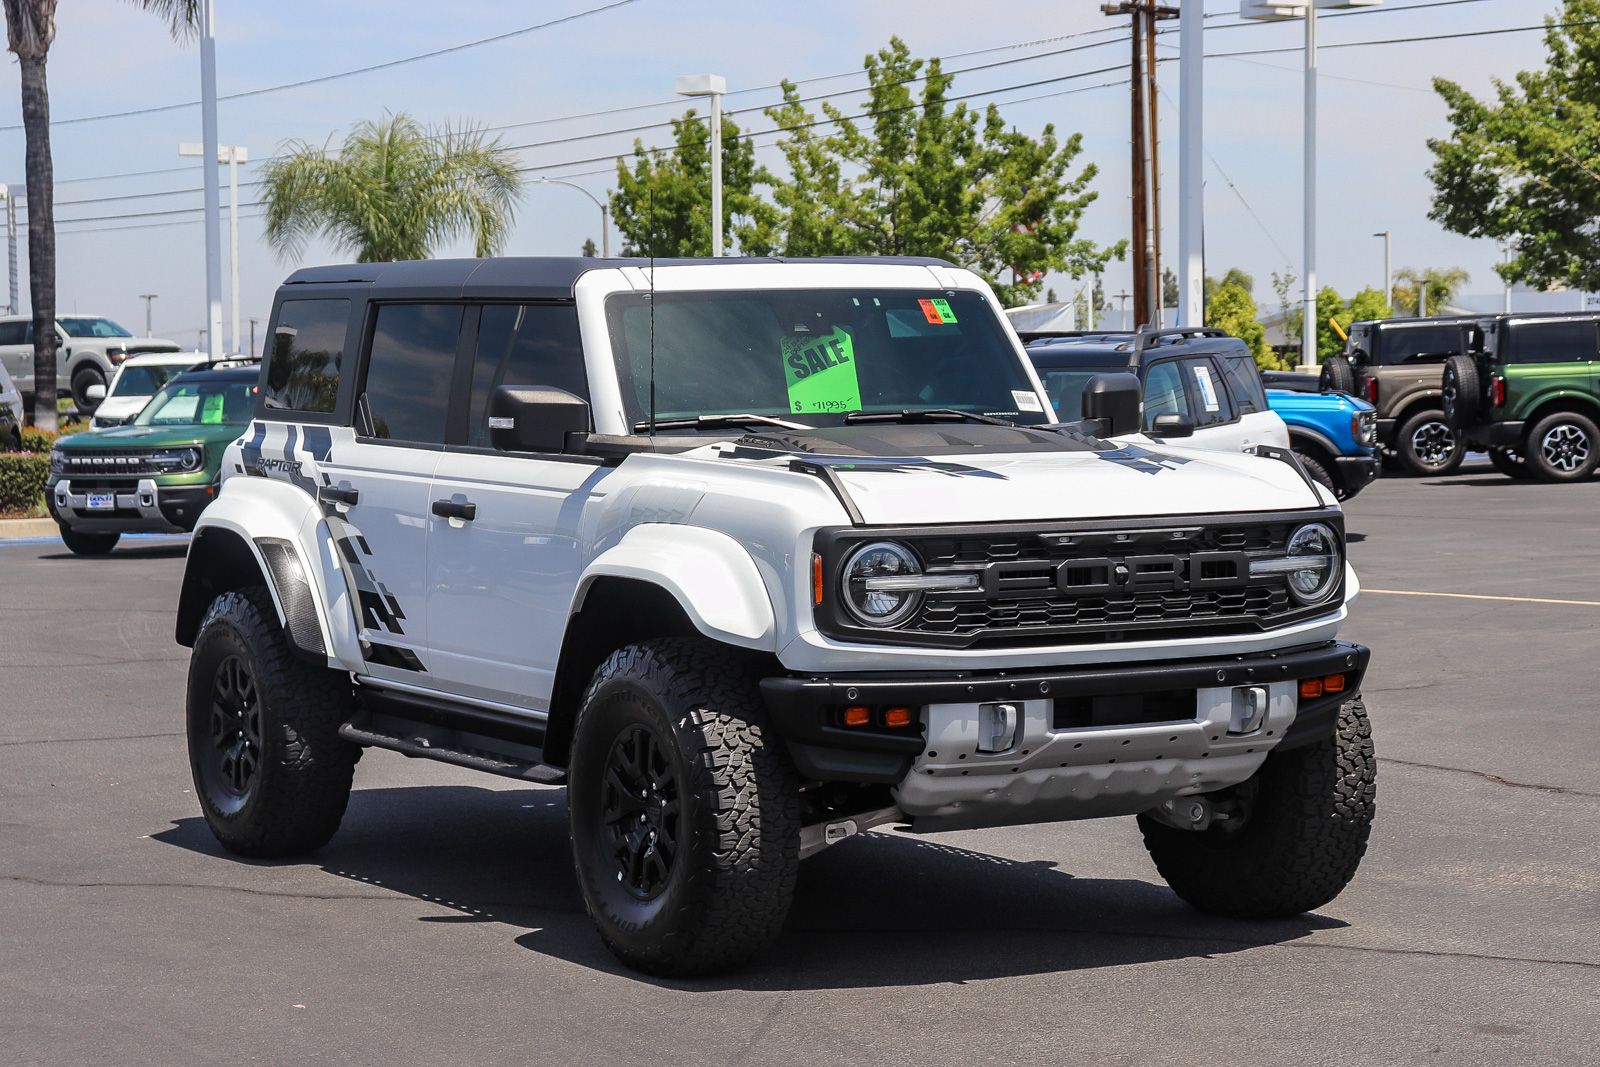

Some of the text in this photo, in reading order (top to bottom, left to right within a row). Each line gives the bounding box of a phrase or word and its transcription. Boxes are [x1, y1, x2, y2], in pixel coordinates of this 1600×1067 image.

[788, 338, 850, 379] SALE
[794, 400, 803, 412] $
[256, 457, 303, 480] RAPTOR
[987, 550, 1249, 600] FORD
